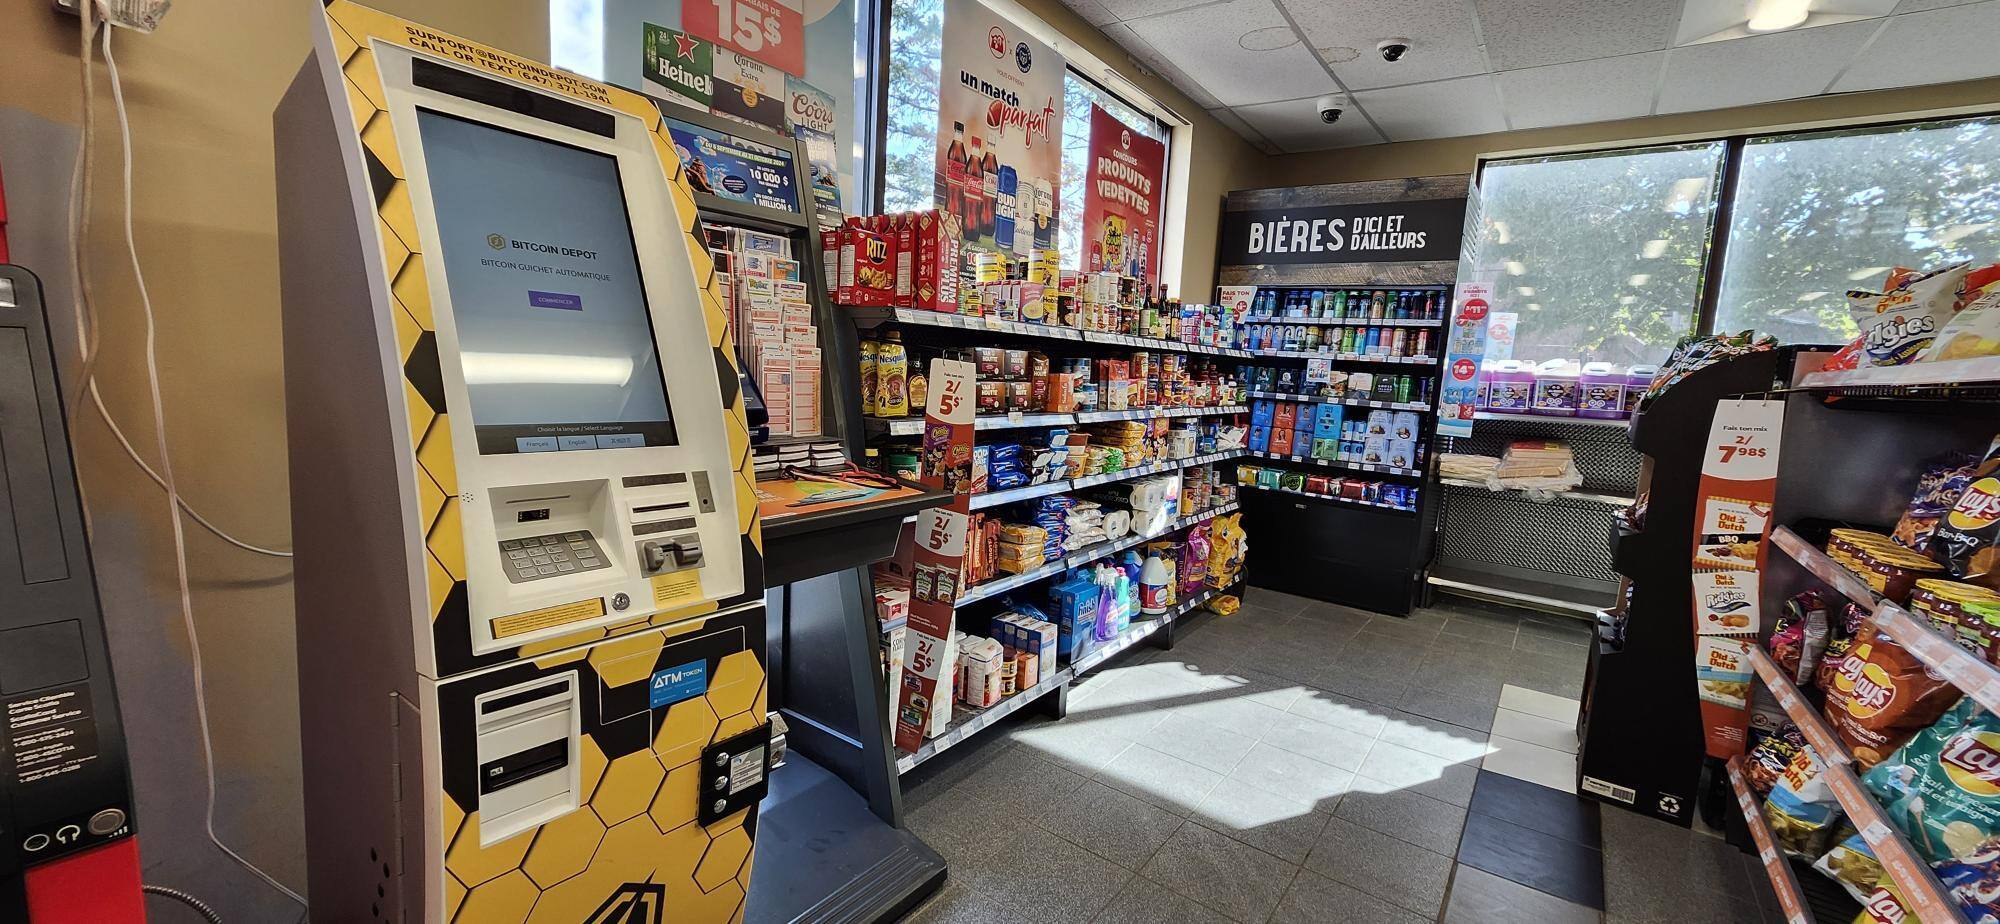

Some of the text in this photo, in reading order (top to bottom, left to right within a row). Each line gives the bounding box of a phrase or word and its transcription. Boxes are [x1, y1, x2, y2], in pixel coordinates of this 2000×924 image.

[770, 7, 781, 17] DE
[406, 26, 608, 96] SUPPORT@BITCOINDEPOT.COM
[409, 36, 612, 105] CALL OR TEXT (647) 371-1941
[741, 68, 759, 82] Extra
[961, 70, 1019, 107] un match
[792, 91, 834, 124] Coors
[801, 117, 828, 131] LIGHT
[1000, 97, 1055, 149] parfait
[1113, 149, 1138, 166] CONCOURS
[750, 168, 761, 180] 10
[763, 171, 780, 184] 000
[783, 176, 789, 186] $
[1098, 157, 1151, 195] PRODUITS
[759, 199, 787, 211] MILLION
[1097, 180, 1150, 215] VEDETTES
[1248, 215, 1405, 254] BIÈRES D'ICI ET
[1350, 232, 1427, 250] D'AILLEURS
[512, 240, 598, 260] BITCOIN DEPOT
[867, 237, 887, 260] RITZ
[481, 258, 612, 281] BITCOIN GUICHET AUTOMATIQUE
[948, 239, 959, 304] PREMIUM
[941, 268, 950, 303] PLUS
[946, 380, 961, 394] 2/
[1735, 435, 1753, 445] 2/
[935, 516, 951, 530] 2/
[1718, 520, 1745, 532] Dutch
[1719, 513, 1736, 523] Old
[1718, 535, 1739, 544] BBQ
[1706, 590, 1745, 608] Ridgies
[918, 641, 933, 654] 2/
[1711, 650, 1728, 661] Old
[1709, 657, 1736, 671] Dutch
[654, 668, 703, 688] ATM TOKEN
